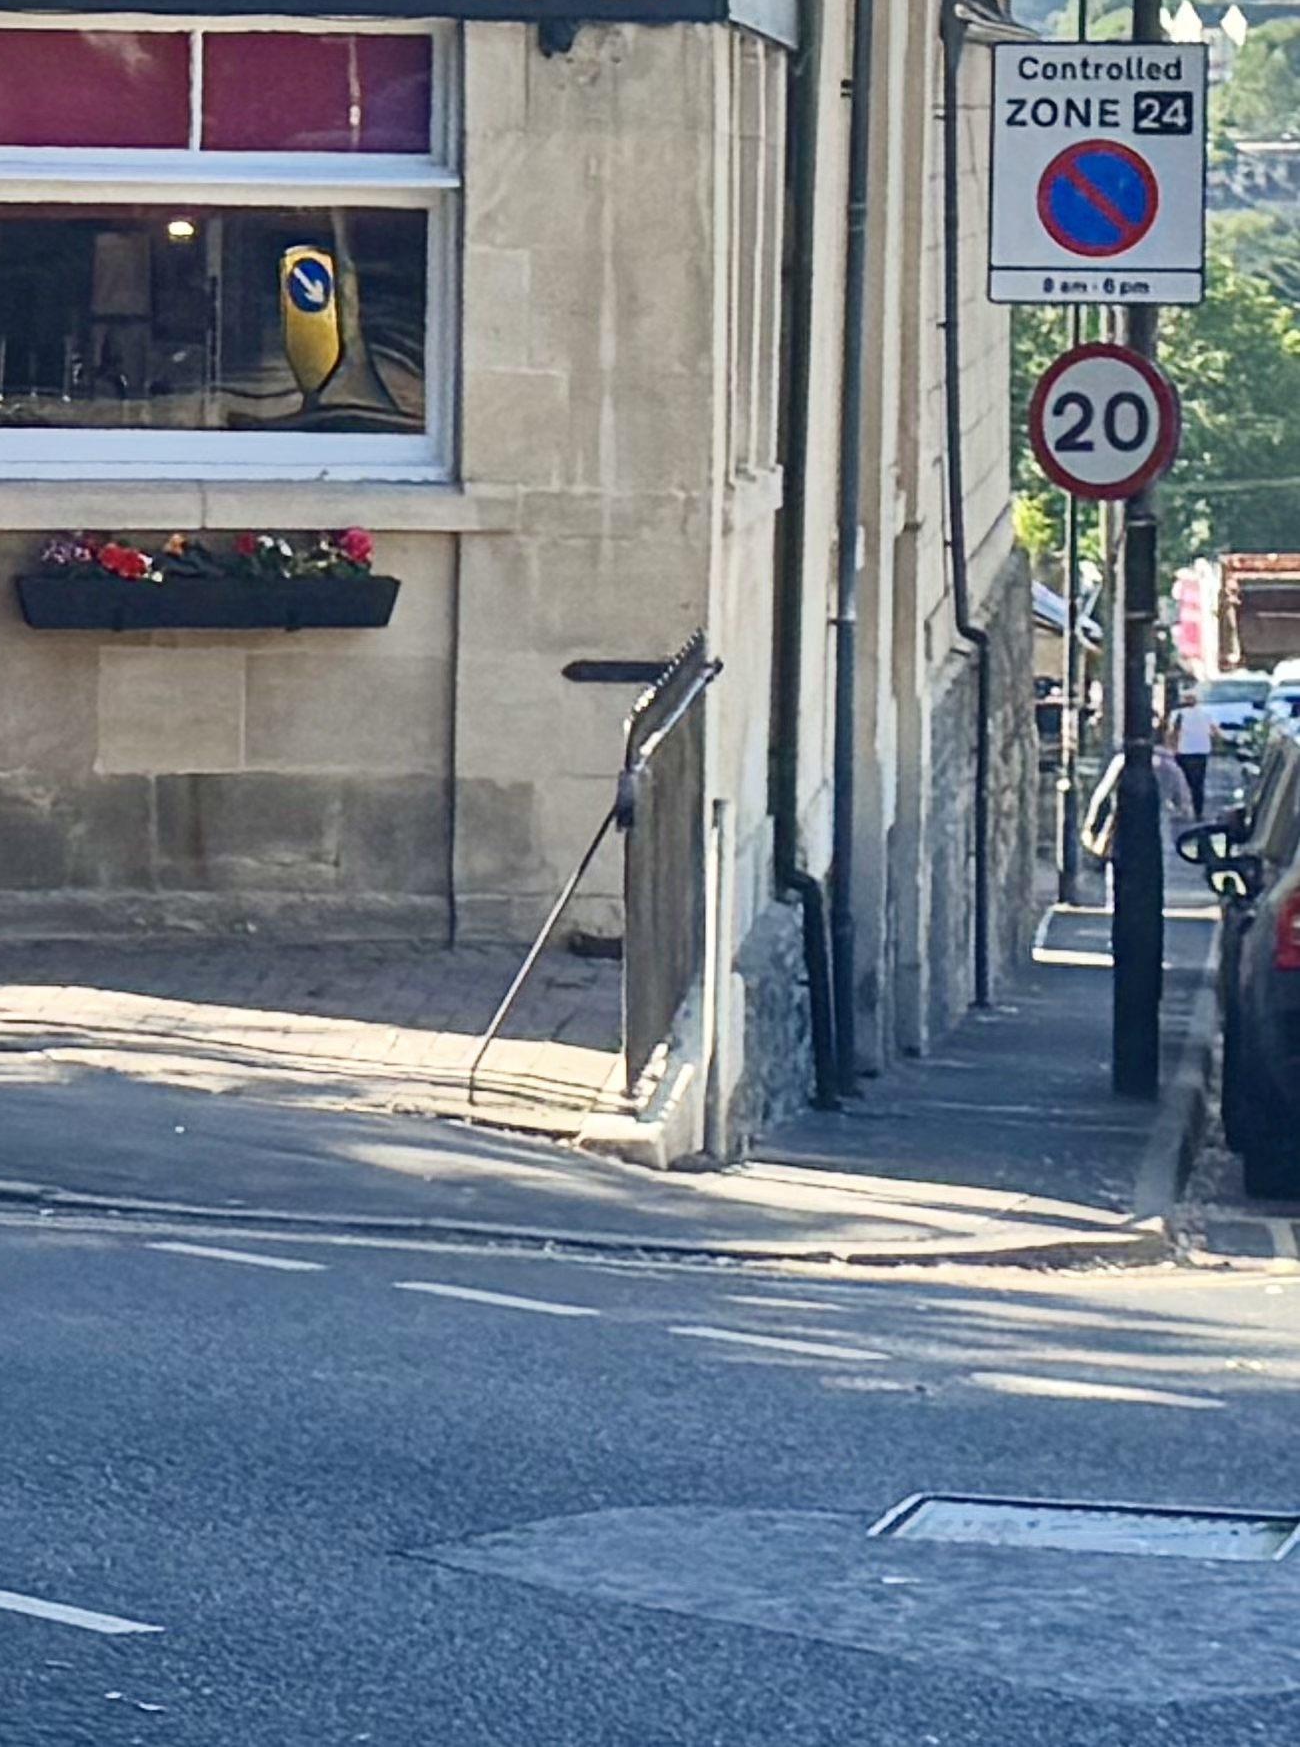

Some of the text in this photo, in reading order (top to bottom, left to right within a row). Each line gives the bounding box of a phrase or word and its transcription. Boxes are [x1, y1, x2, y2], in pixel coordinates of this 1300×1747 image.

[1018, 56, 1182, 81] Controlled
[1006, 98, 1187, 128] ZONE 24
[1061, 281, 1087, 293] am
[1103, 277, 1114, 294] 6
[1120, 281, 1150, 296] pm
[1052, 392, 1149, 452] 20
